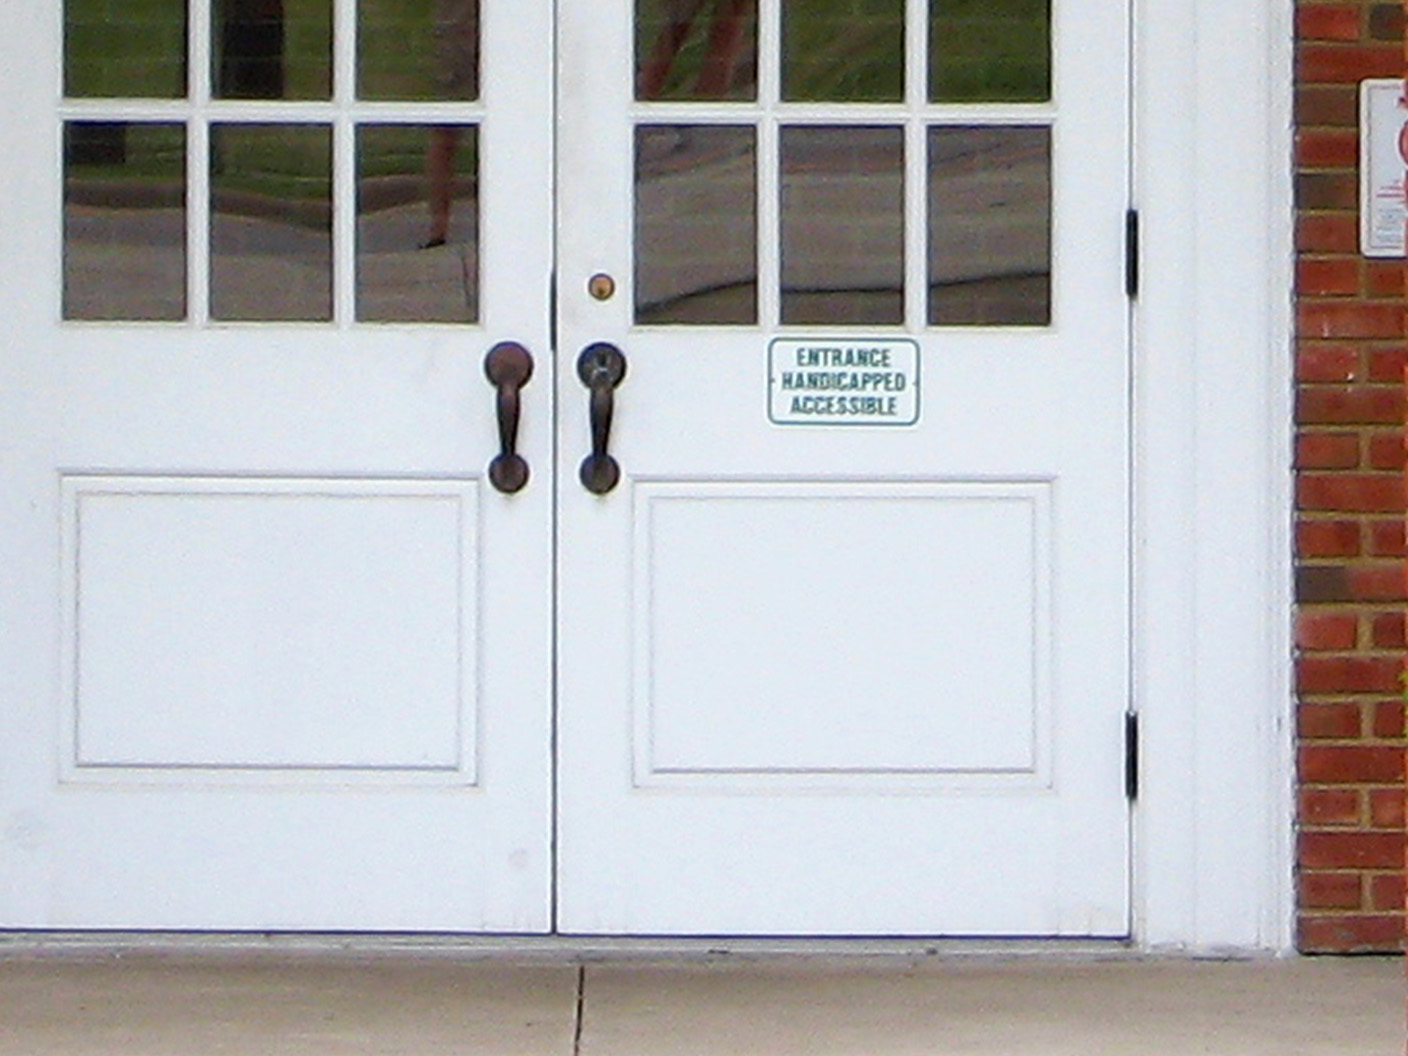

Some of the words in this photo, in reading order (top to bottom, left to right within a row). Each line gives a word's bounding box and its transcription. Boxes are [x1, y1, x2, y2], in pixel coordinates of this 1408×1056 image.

[796, 347, 891, 367] ENTRANCE
[781, 372, 906, 392] HANDICAPPED
[789, 396, 898, 415] ACCESSIBLE
